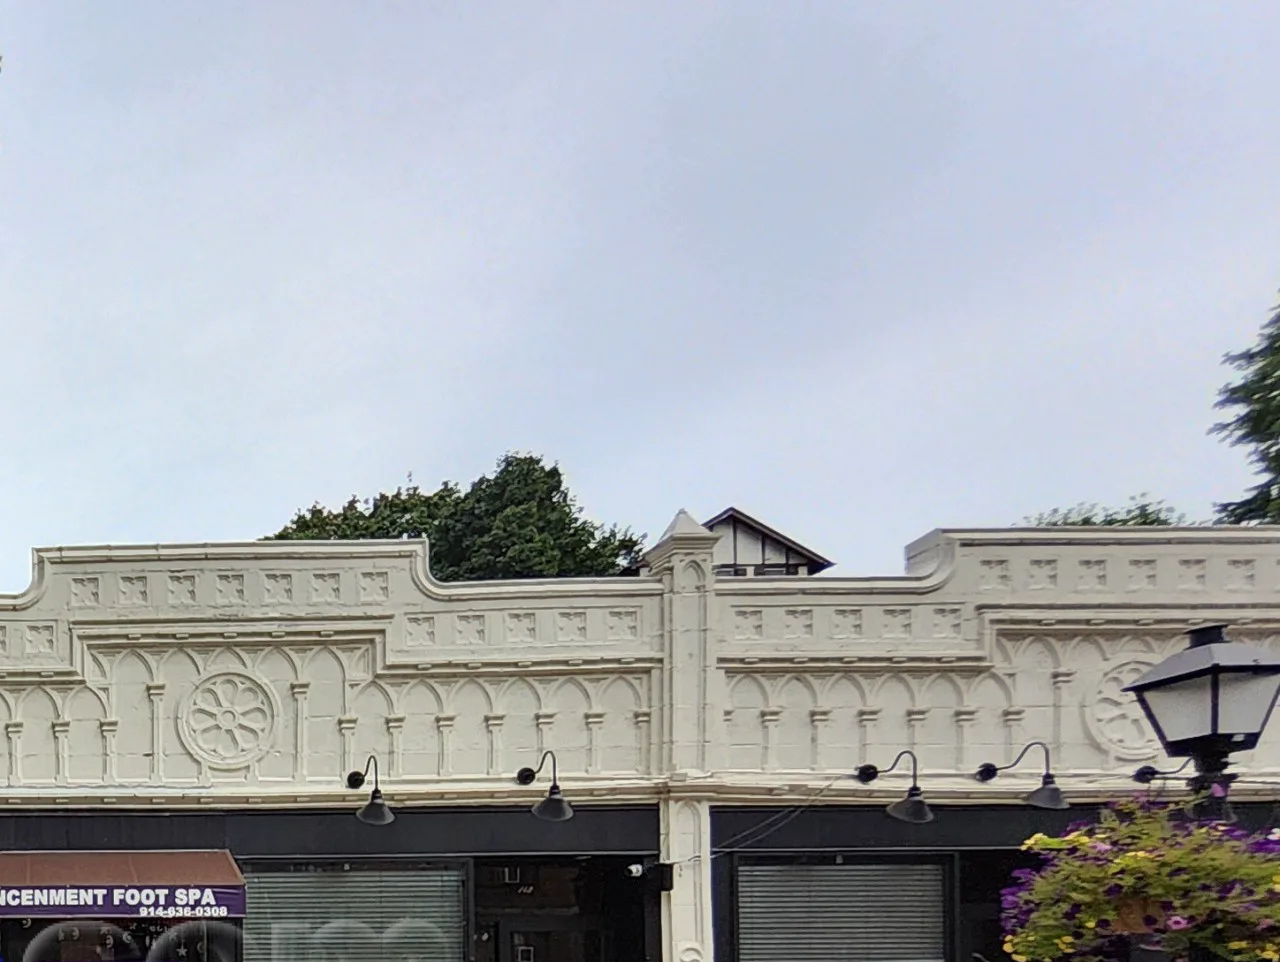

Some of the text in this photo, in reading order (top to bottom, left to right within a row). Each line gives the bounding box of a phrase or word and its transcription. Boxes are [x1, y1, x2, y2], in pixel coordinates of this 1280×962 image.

[113, 888, 169, 906] FOOT
[175, 888, 217, 906] SPA
[139, 906, 228, 918] 914-636-0308
